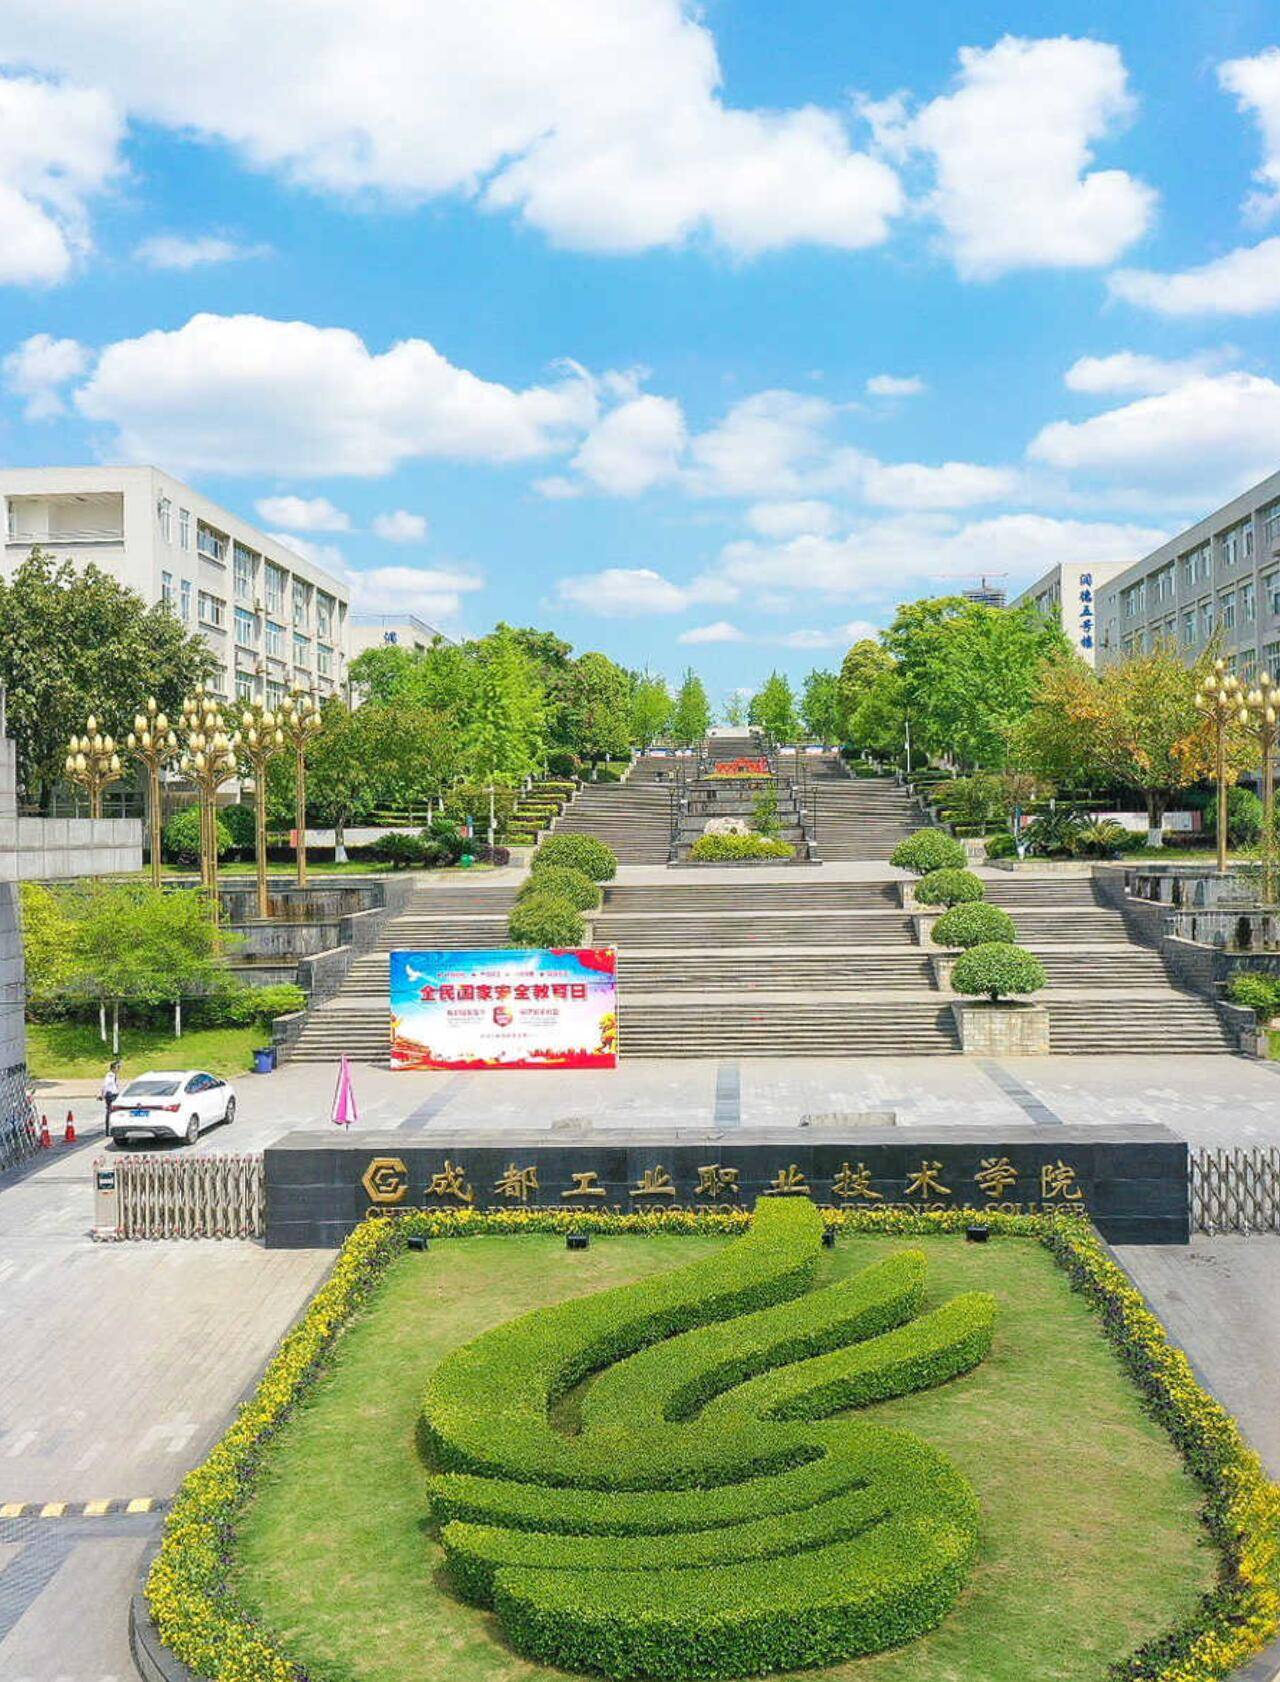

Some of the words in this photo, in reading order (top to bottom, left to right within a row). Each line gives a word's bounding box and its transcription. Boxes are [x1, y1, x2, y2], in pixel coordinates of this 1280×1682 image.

[424, 1157, 1083, 1201] 成都工业职业技术学院
